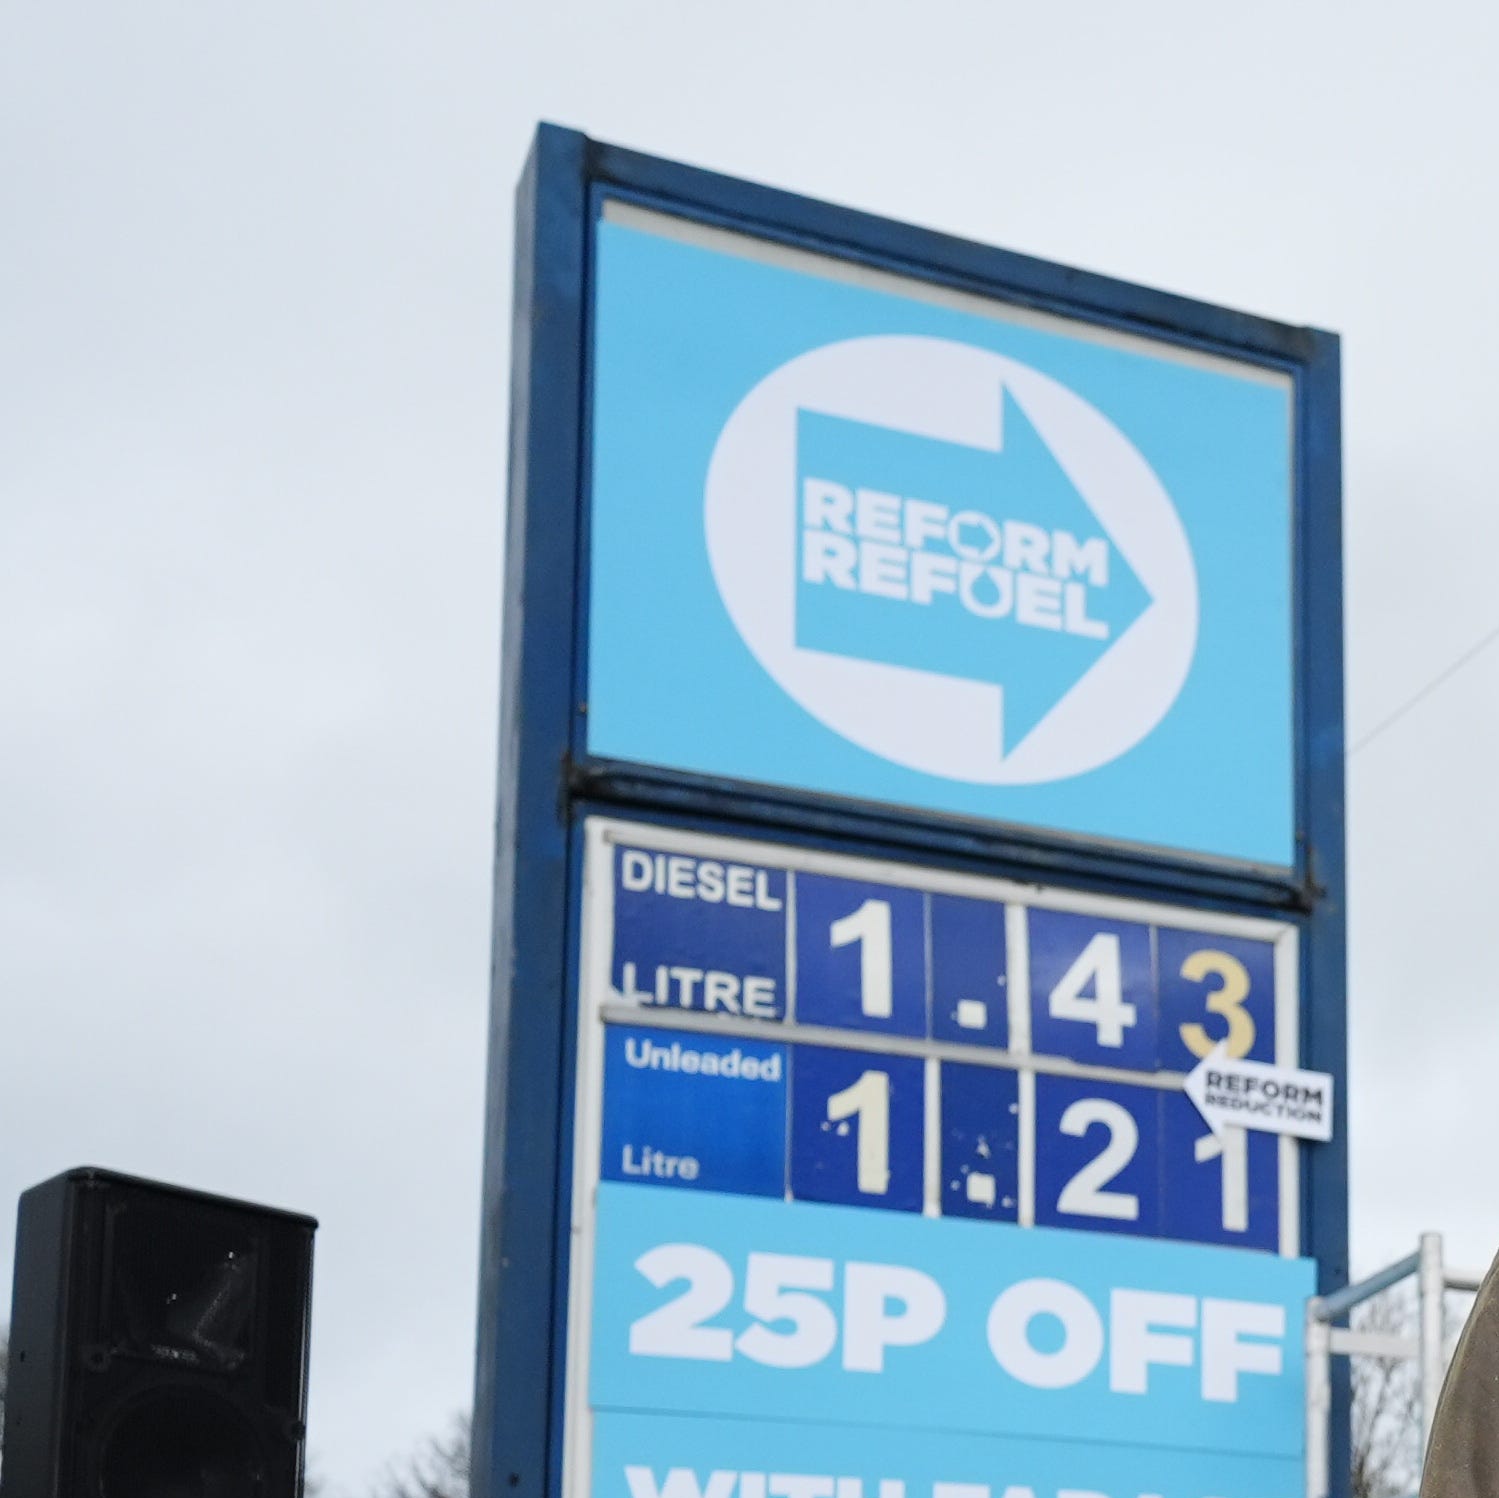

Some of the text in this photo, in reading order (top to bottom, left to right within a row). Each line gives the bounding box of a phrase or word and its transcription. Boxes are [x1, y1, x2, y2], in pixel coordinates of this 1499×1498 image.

[802, 476, 1110, 587] REFORM
[802, 529, 1110, 640] REFUEL
[622, 850, 783, 912] DIESEL
[622, 961, 777, 1019] LITRE
[624, 1037, 783, 1083] Unleaded
[1206, 1070, 1323, 1107] REFORM
[1205, 1093, 1323, 1123] REDUCTION
[622, 1143, 700, 1181] Litre
[629, 1242, 1286, 1403] 25P OFF
